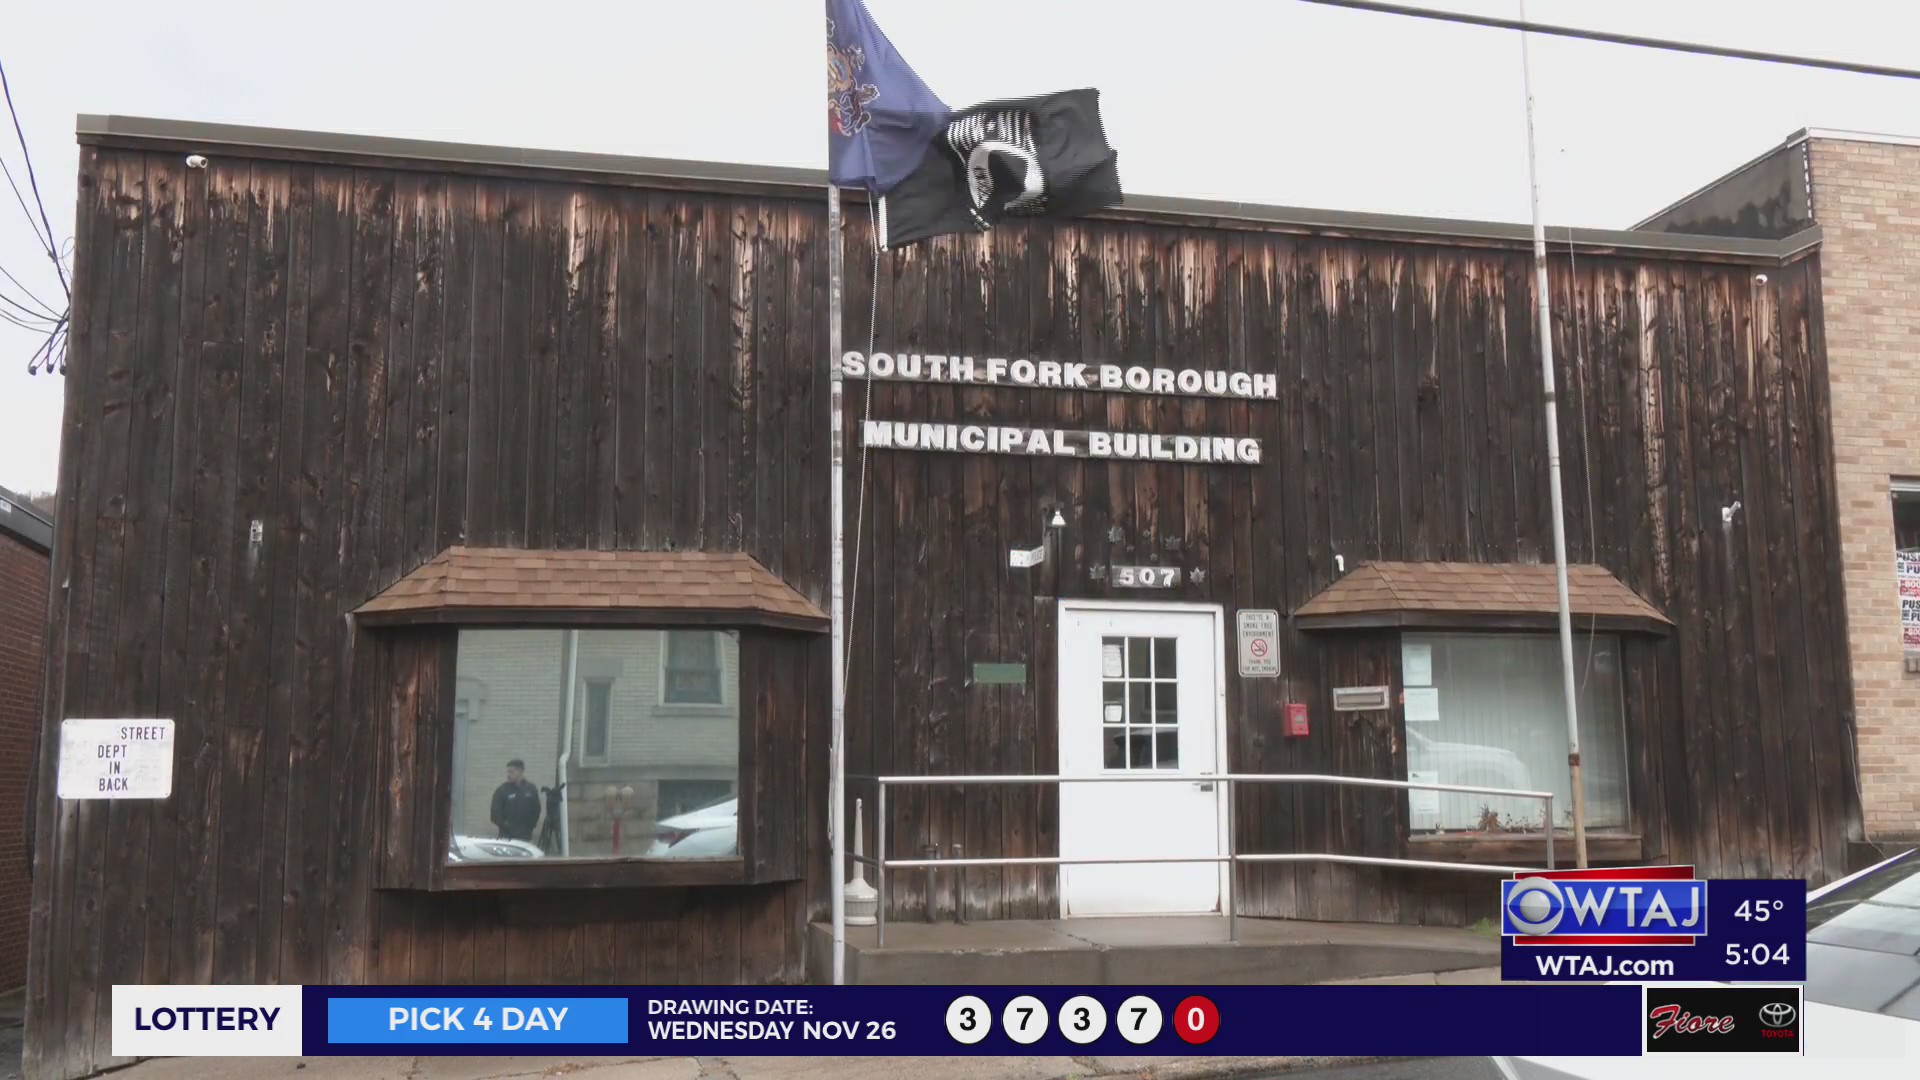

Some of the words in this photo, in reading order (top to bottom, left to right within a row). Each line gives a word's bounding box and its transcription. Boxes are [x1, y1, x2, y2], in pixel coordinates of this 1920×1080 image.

[842, 351, 974, 382] SOUTH
[987, 358, 1089, 389] FORK
[1099, 364, 1277, 399] BOROUGH
[863, 421, 1076, 456] MUNICIPAL
[1089, 432, 1261, 464] BUILDING
[1896, 552, 1920, 562] PUS
[1119, 567, 1175, 588] 507
[120, 726, 166, 740] STREET
[97, 744, 128, 759] DEPT
[109, 761, 121, 775] IN
[98, 777, 129, 792] BACK
